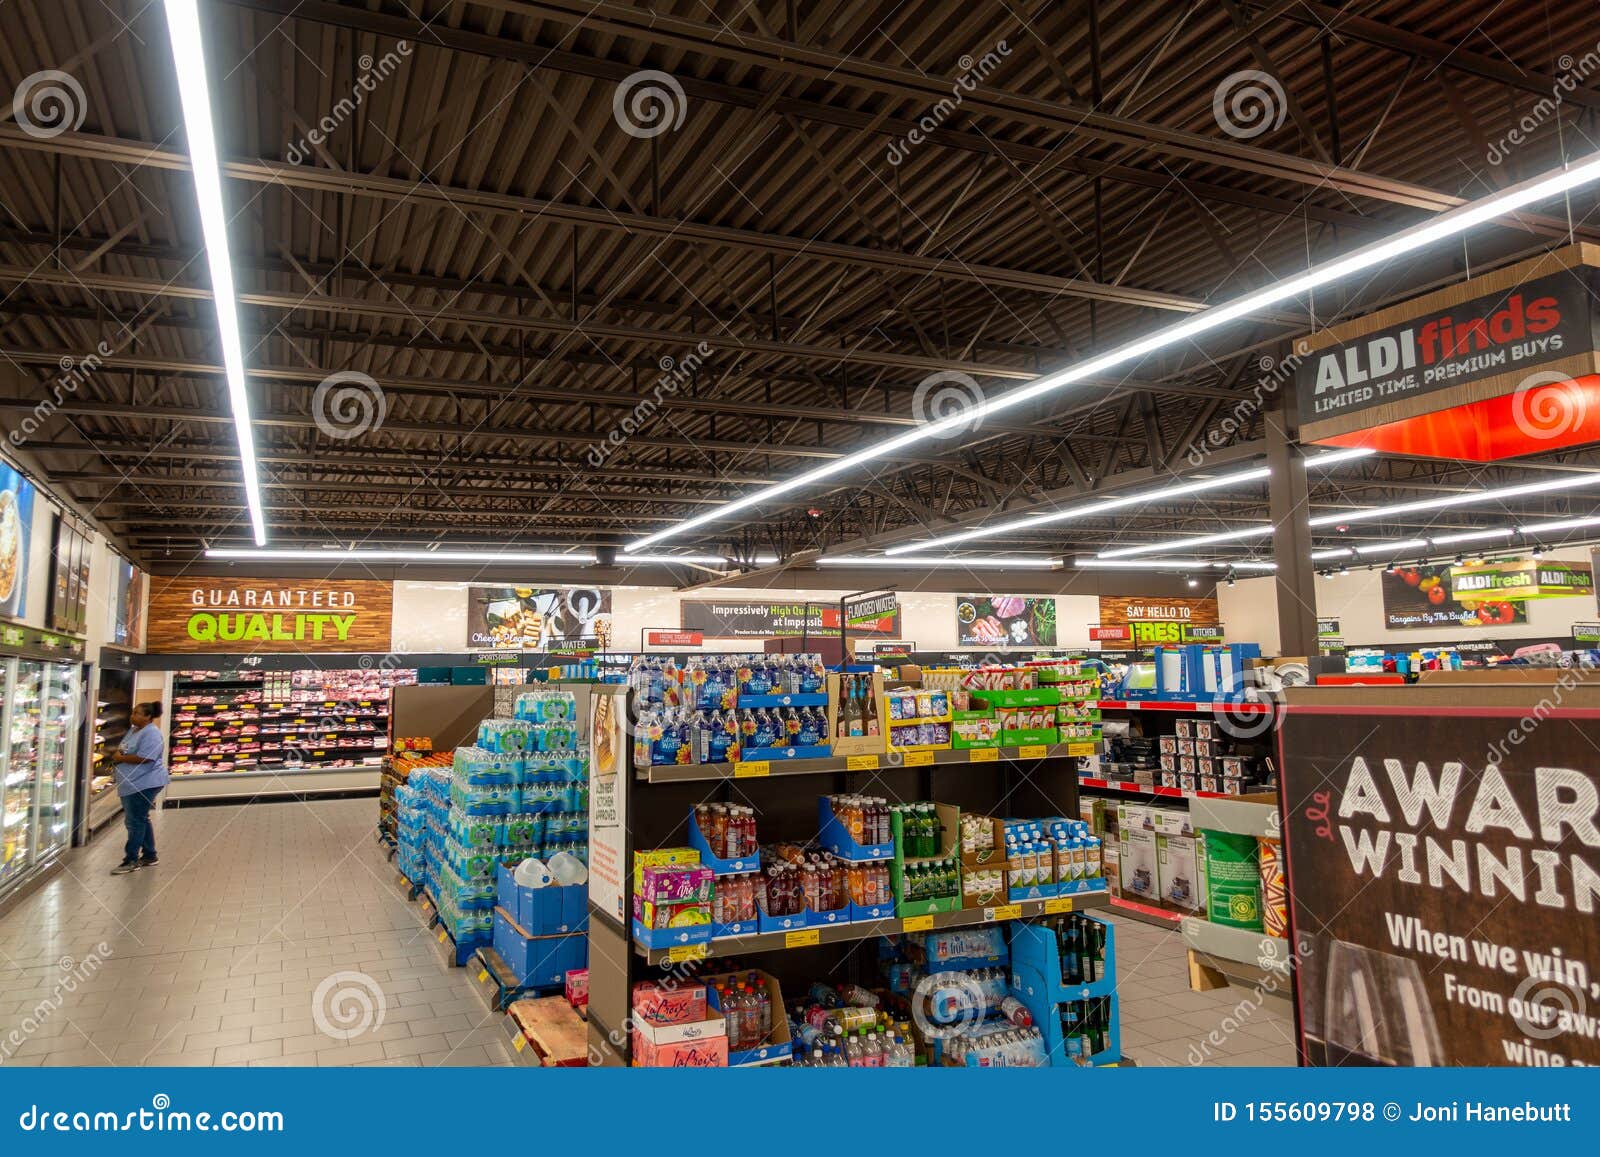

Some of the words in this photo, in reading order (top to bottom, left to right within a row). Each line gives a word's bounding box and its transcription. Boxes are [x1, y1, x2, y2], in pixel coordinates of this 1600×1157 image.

[1314, 294, 1561, 395] ALDIfinds
[1314, 386, 1373, 414] LIMITED
[1424, 350, 1506, 385] PREMIUM
[1511, 334, 1563, 361] BUYS
[1458, 572, 1531, 590] ALDIfresh
[1541, 571, 1590, 585] ALDIfresh
[192, 590, 355, 607] GUARANTEED
[713, 605, 769, 617] Impressively
[771, 605, 791, 617] High
[792, 606, 823, 618] Qulity
[1127, 607, 1145, 617] SAY
[1148, 607, 1176, 617] HELLO
[1179, 607, 1190, 618] TO
[187, 612, 357, 641] QUALITY
[773, 619, 782, 627] at
[561, 641, 587, 649] WATER
[1385, 912, 1468, 962] When
[1472, 939, 1518, 973] we
[1444, 973, 1504, 1015] From
[1508, 998, 1557, 1026] our
[1558, 1009, 1600, 1040] aw
[1502, 1038, 1565, 1066] wine
